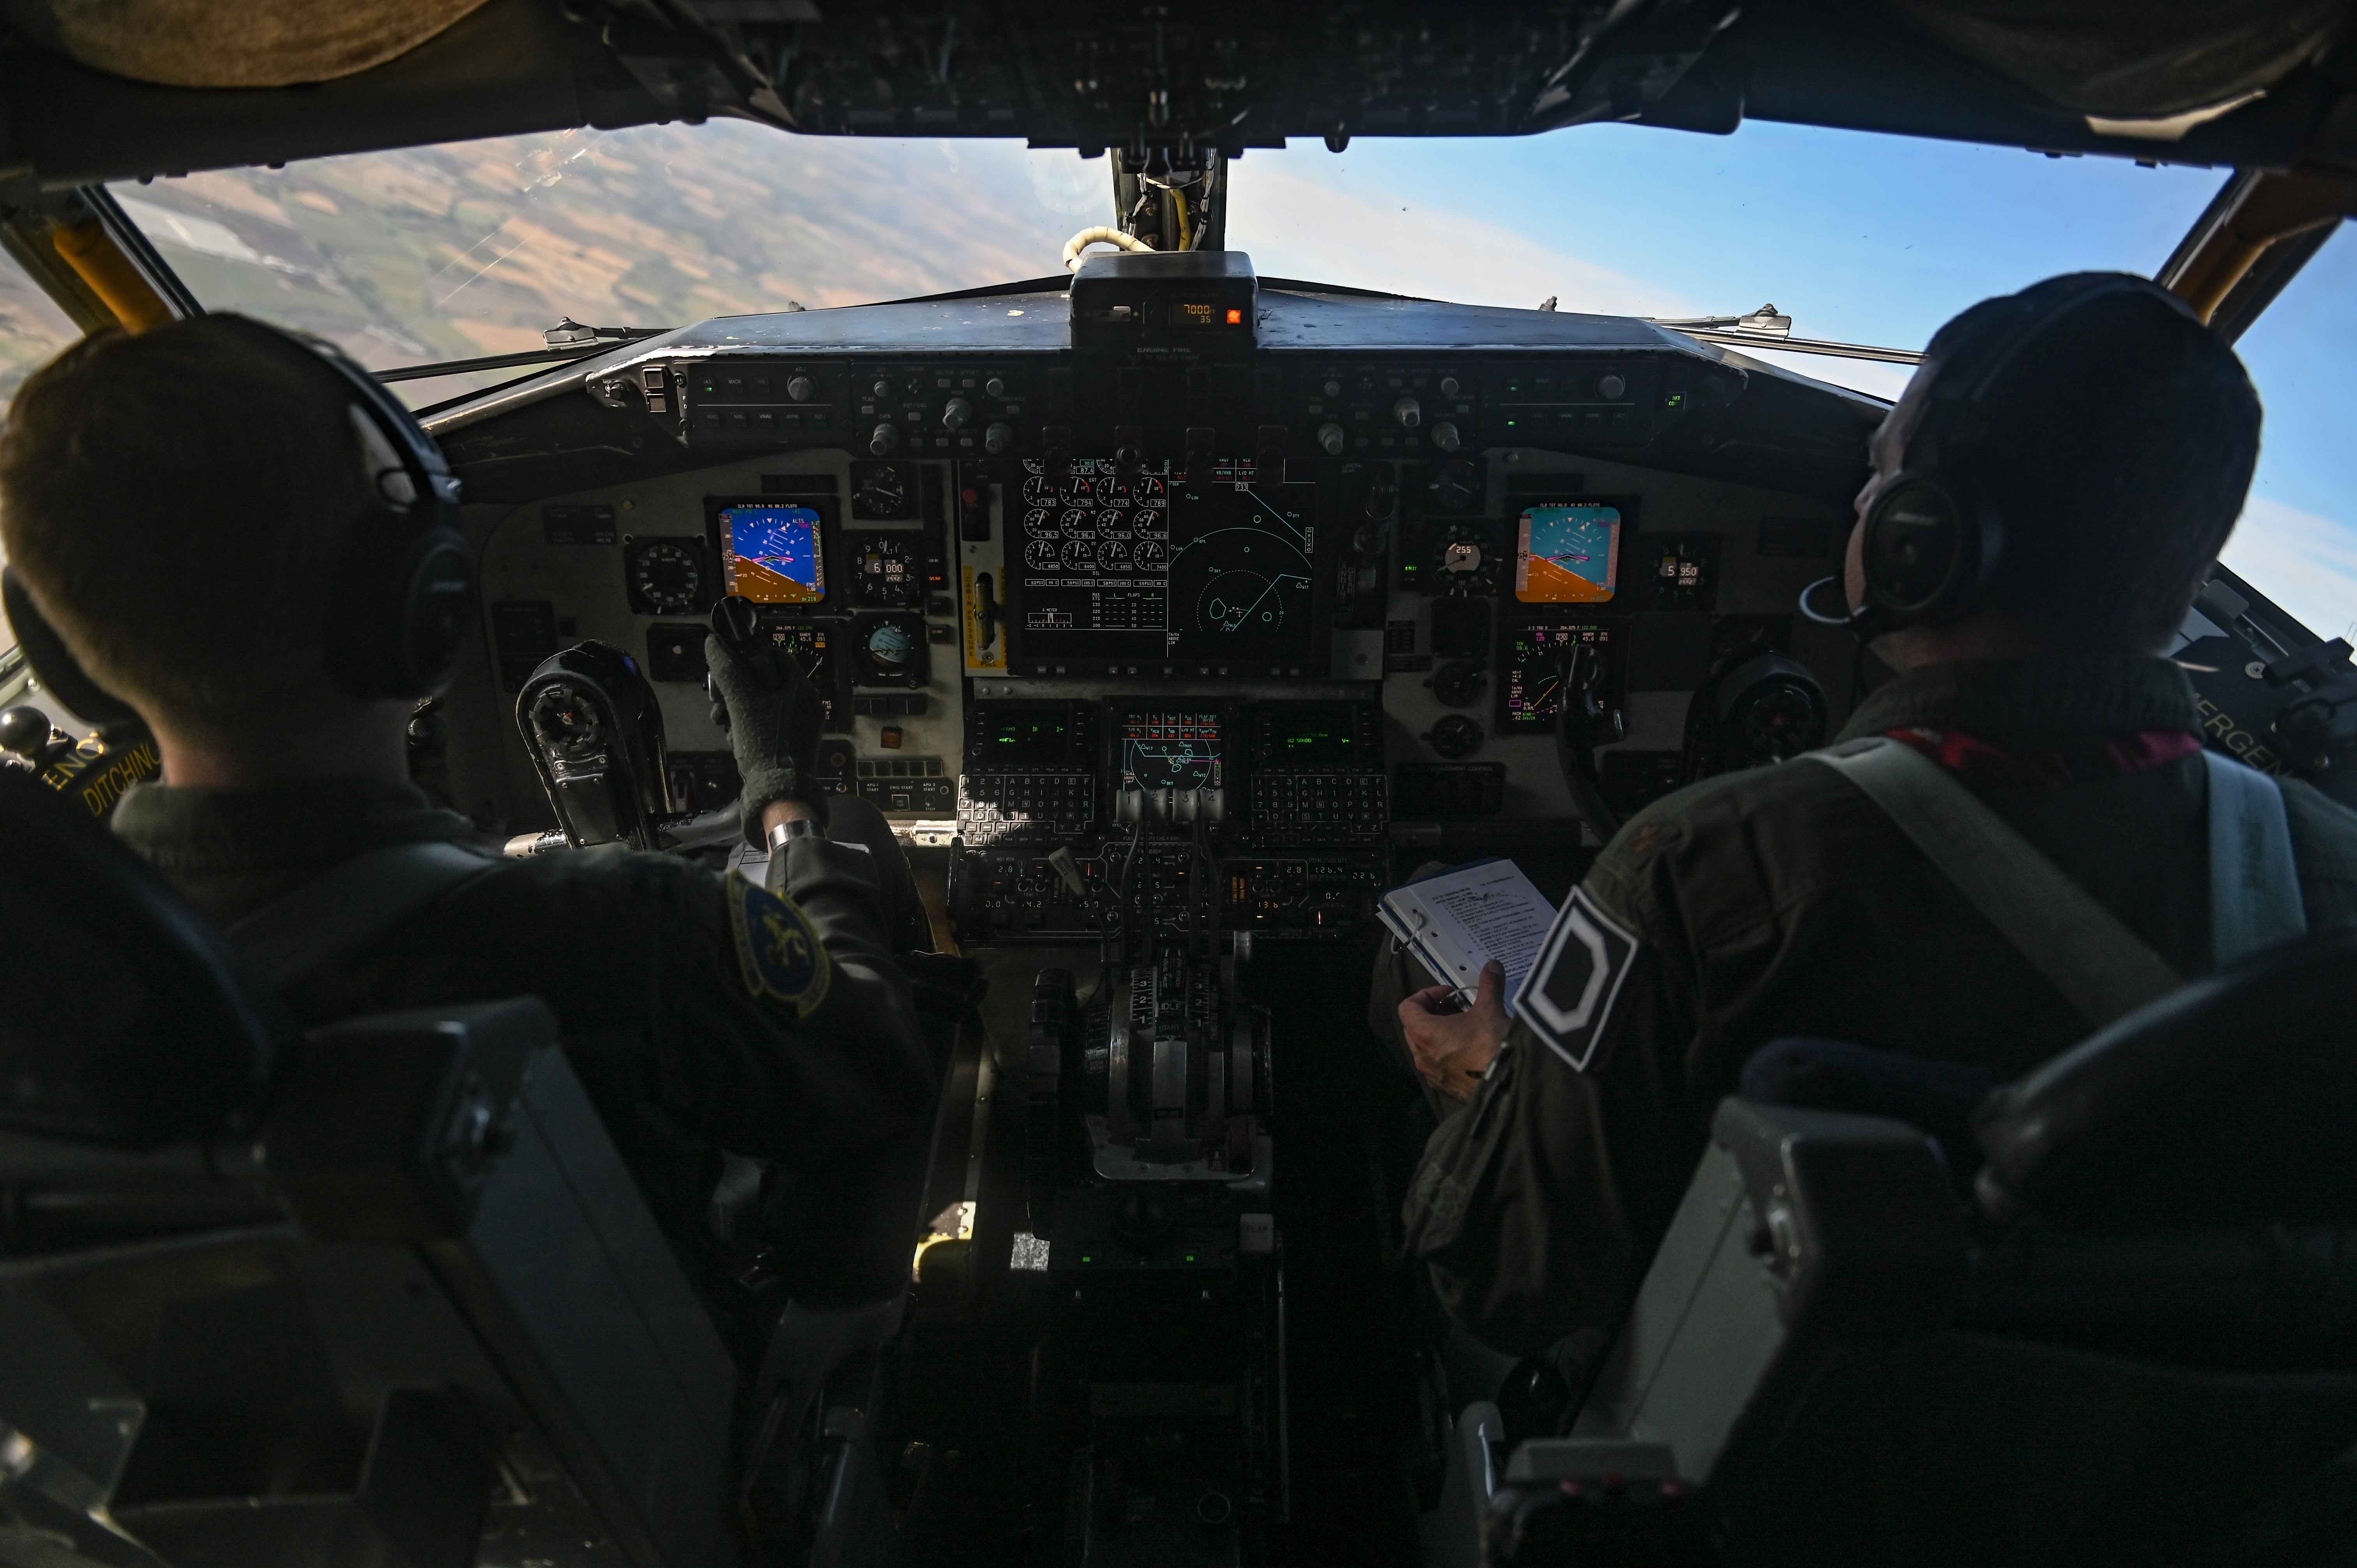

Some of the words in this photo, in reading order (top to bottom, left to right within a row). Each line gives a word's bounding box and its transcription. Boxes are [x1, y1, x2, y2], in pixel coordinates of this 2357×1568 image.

[1184, 304, 1209, 314] 7000
[875, 563, 880, 572] 6
[1668, 566, 1674, 576] 5
[2194, 693, 2283, 775] ERGEN
[1196, 1019, 1201, 1027] 1
